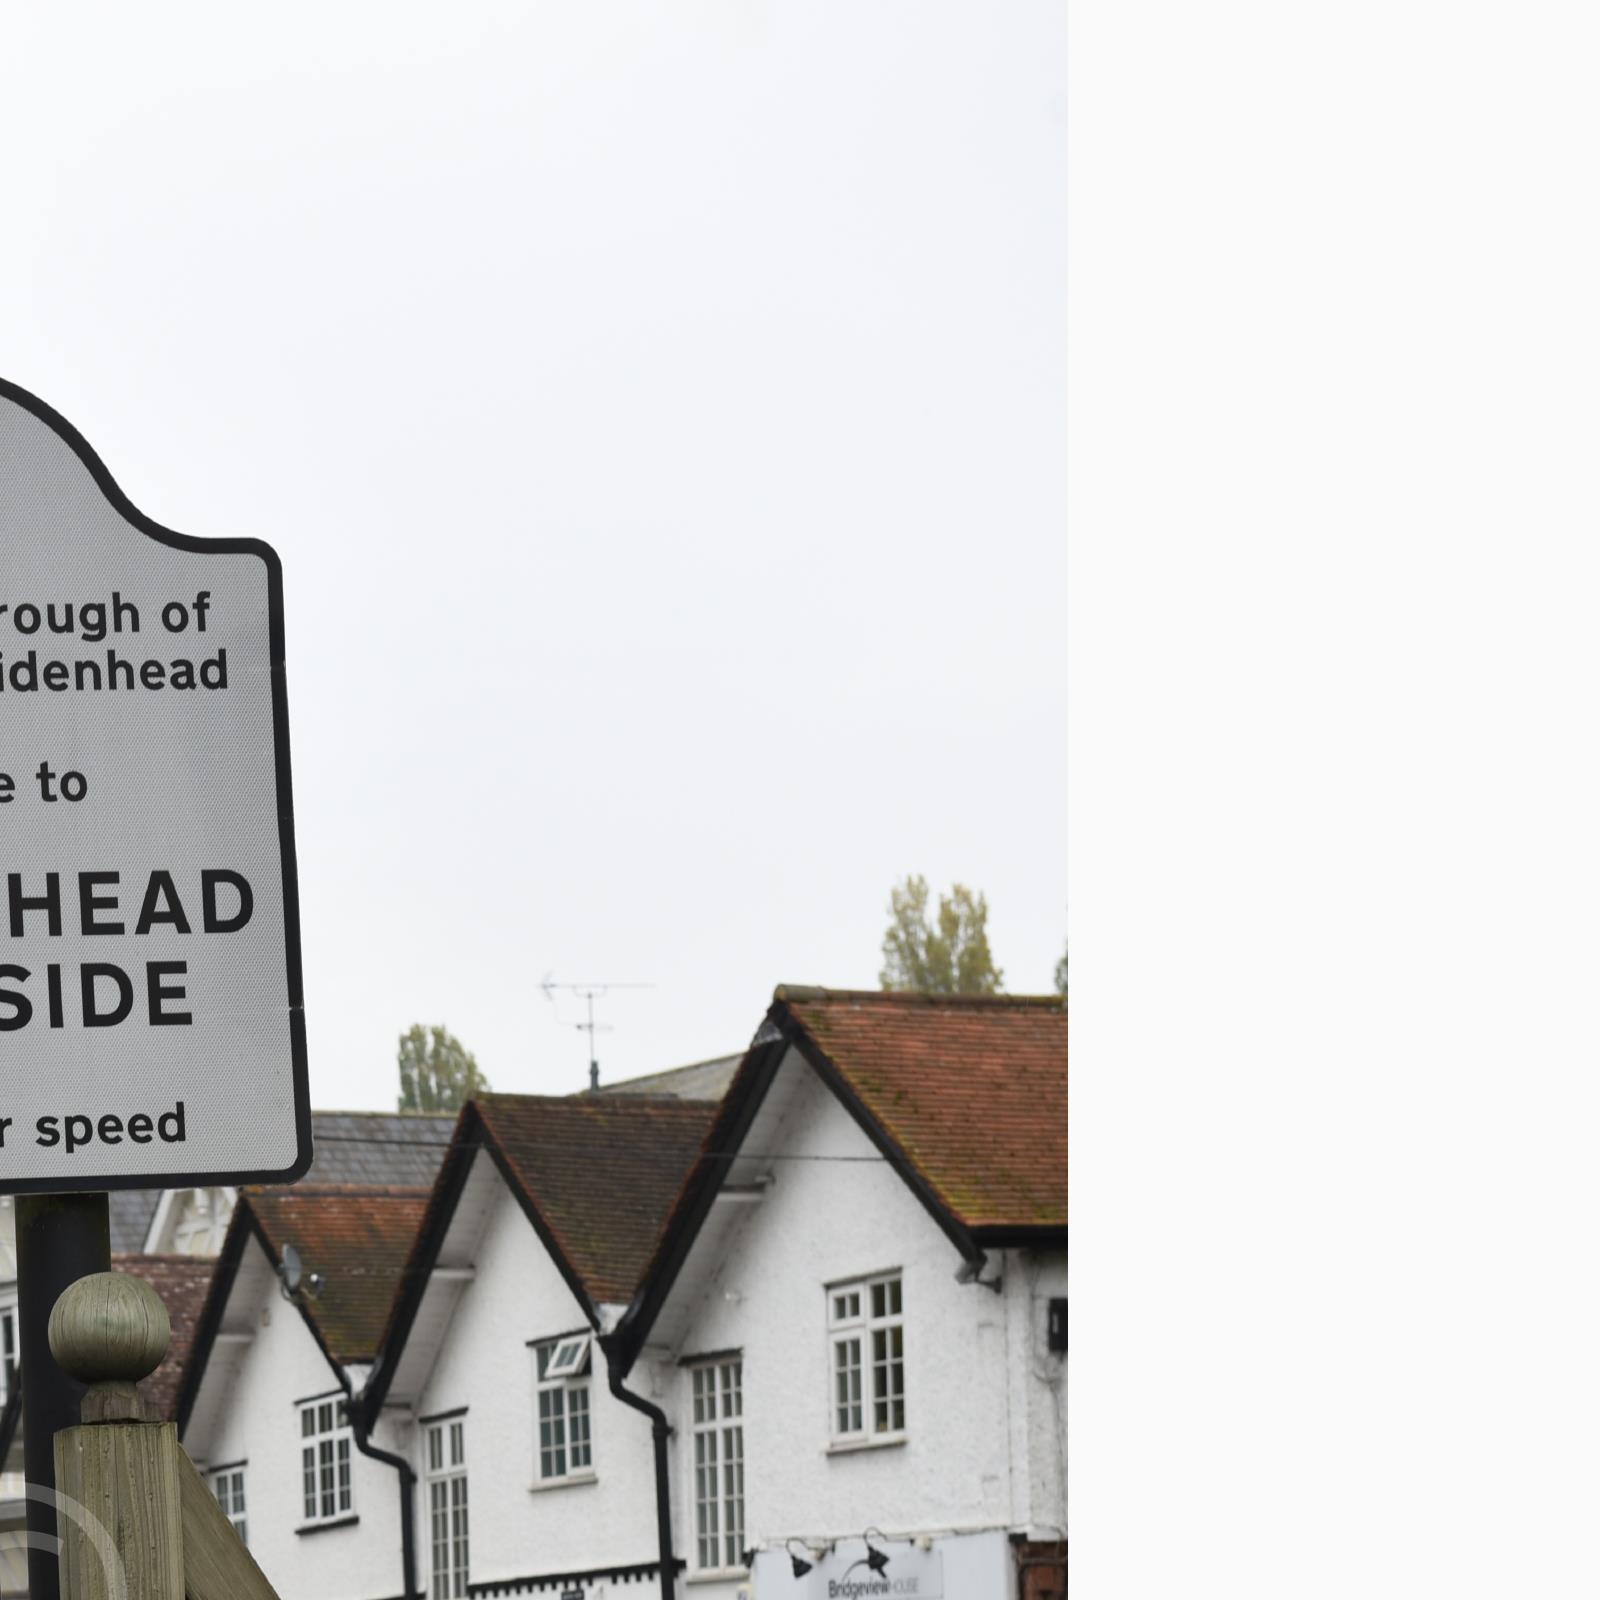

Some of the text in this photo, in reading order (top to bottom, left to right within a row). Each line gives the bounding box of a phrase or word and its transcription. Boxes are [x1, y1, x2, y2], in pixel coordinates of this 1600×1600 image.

[161, 590, 212, 634] of
[35, 760, 89, 804] to
[34, 1101, 188, 1155] speed
